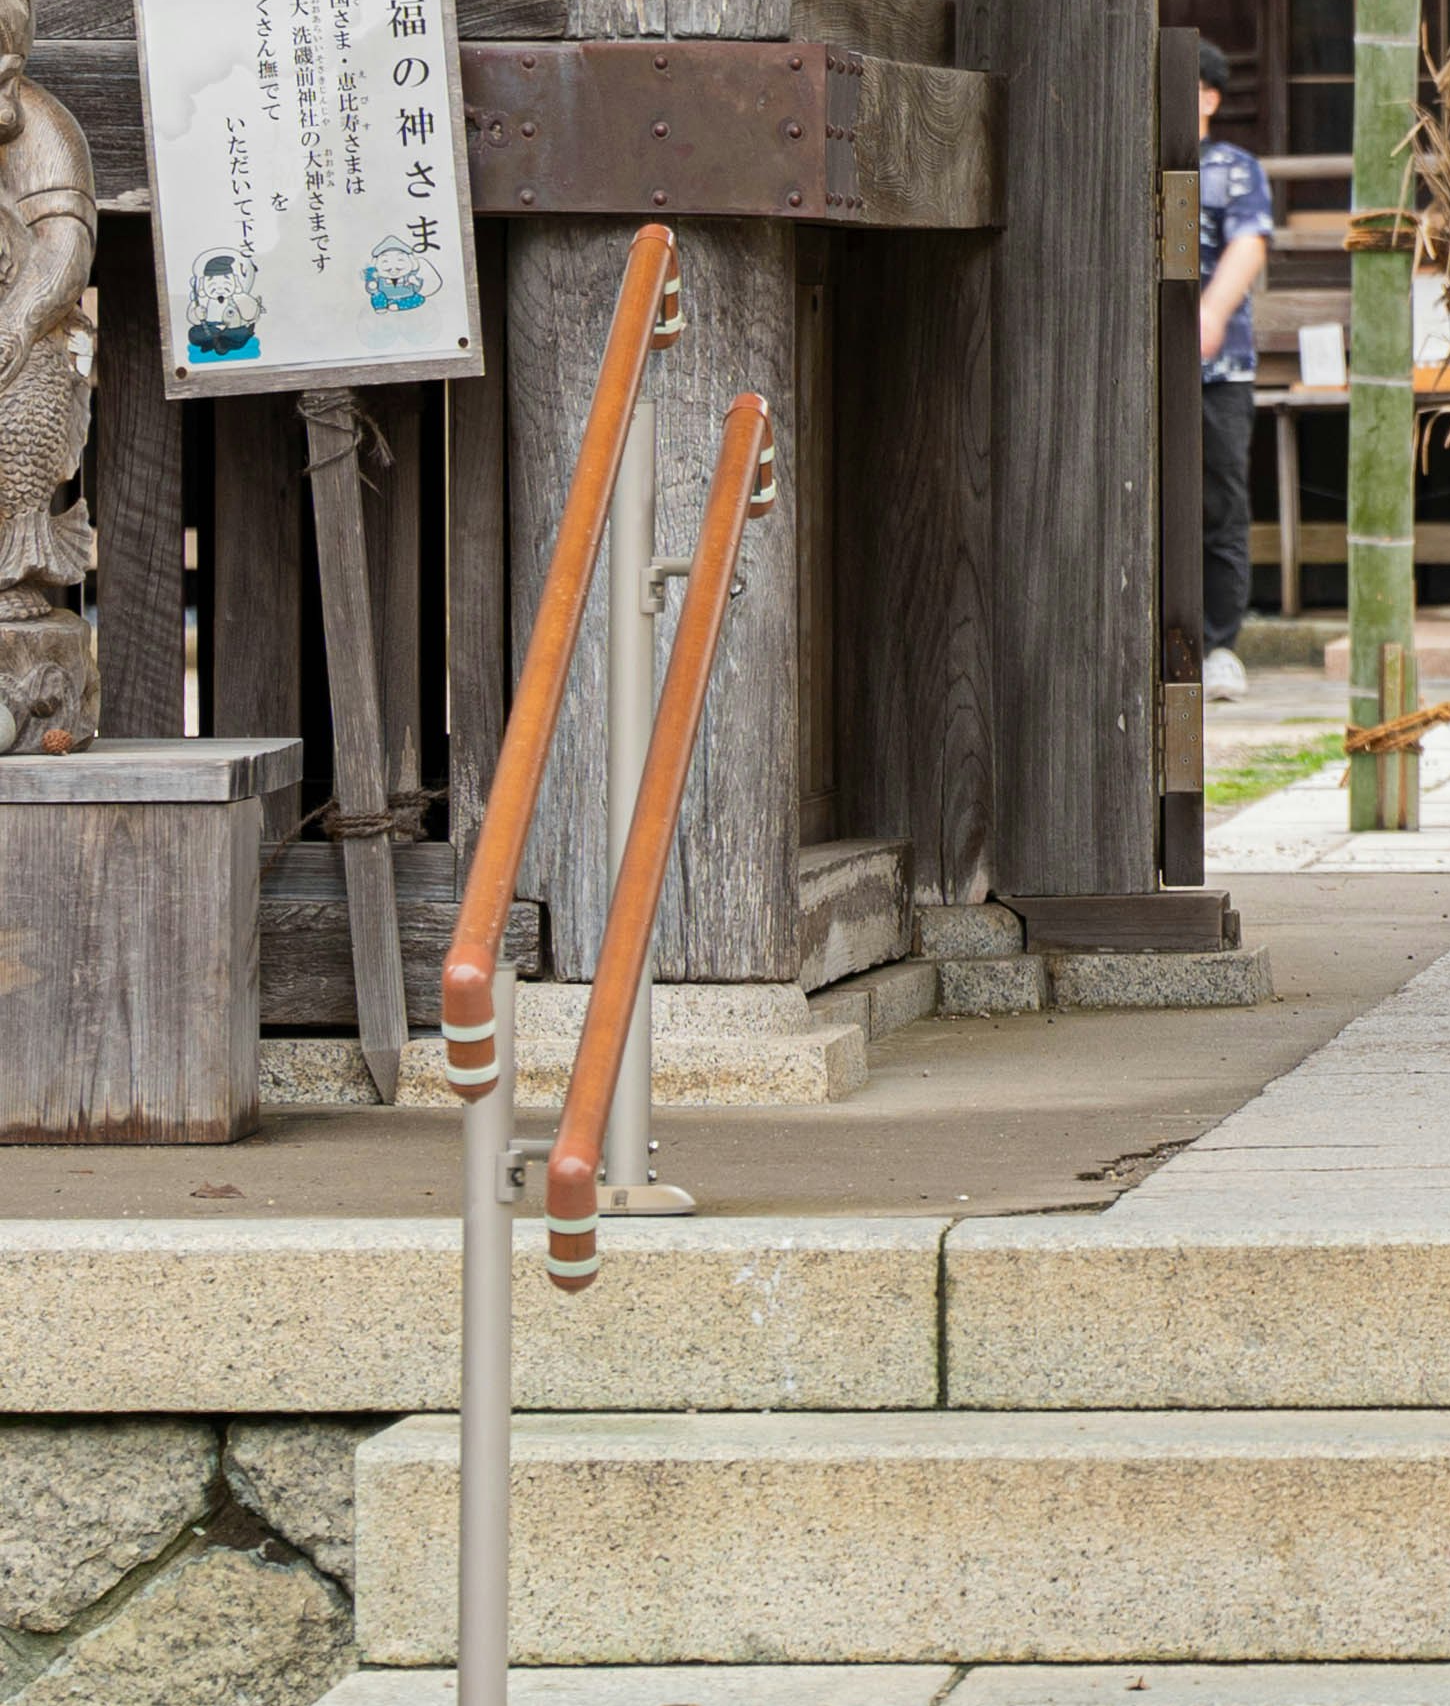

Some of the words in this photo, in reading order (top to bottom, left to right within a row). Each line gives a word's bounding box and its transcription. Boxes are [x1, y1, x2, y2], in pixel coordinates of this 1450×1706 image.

[226, 117, 258, 278] いただいて下さい
[271, 191, 289, 212] を
